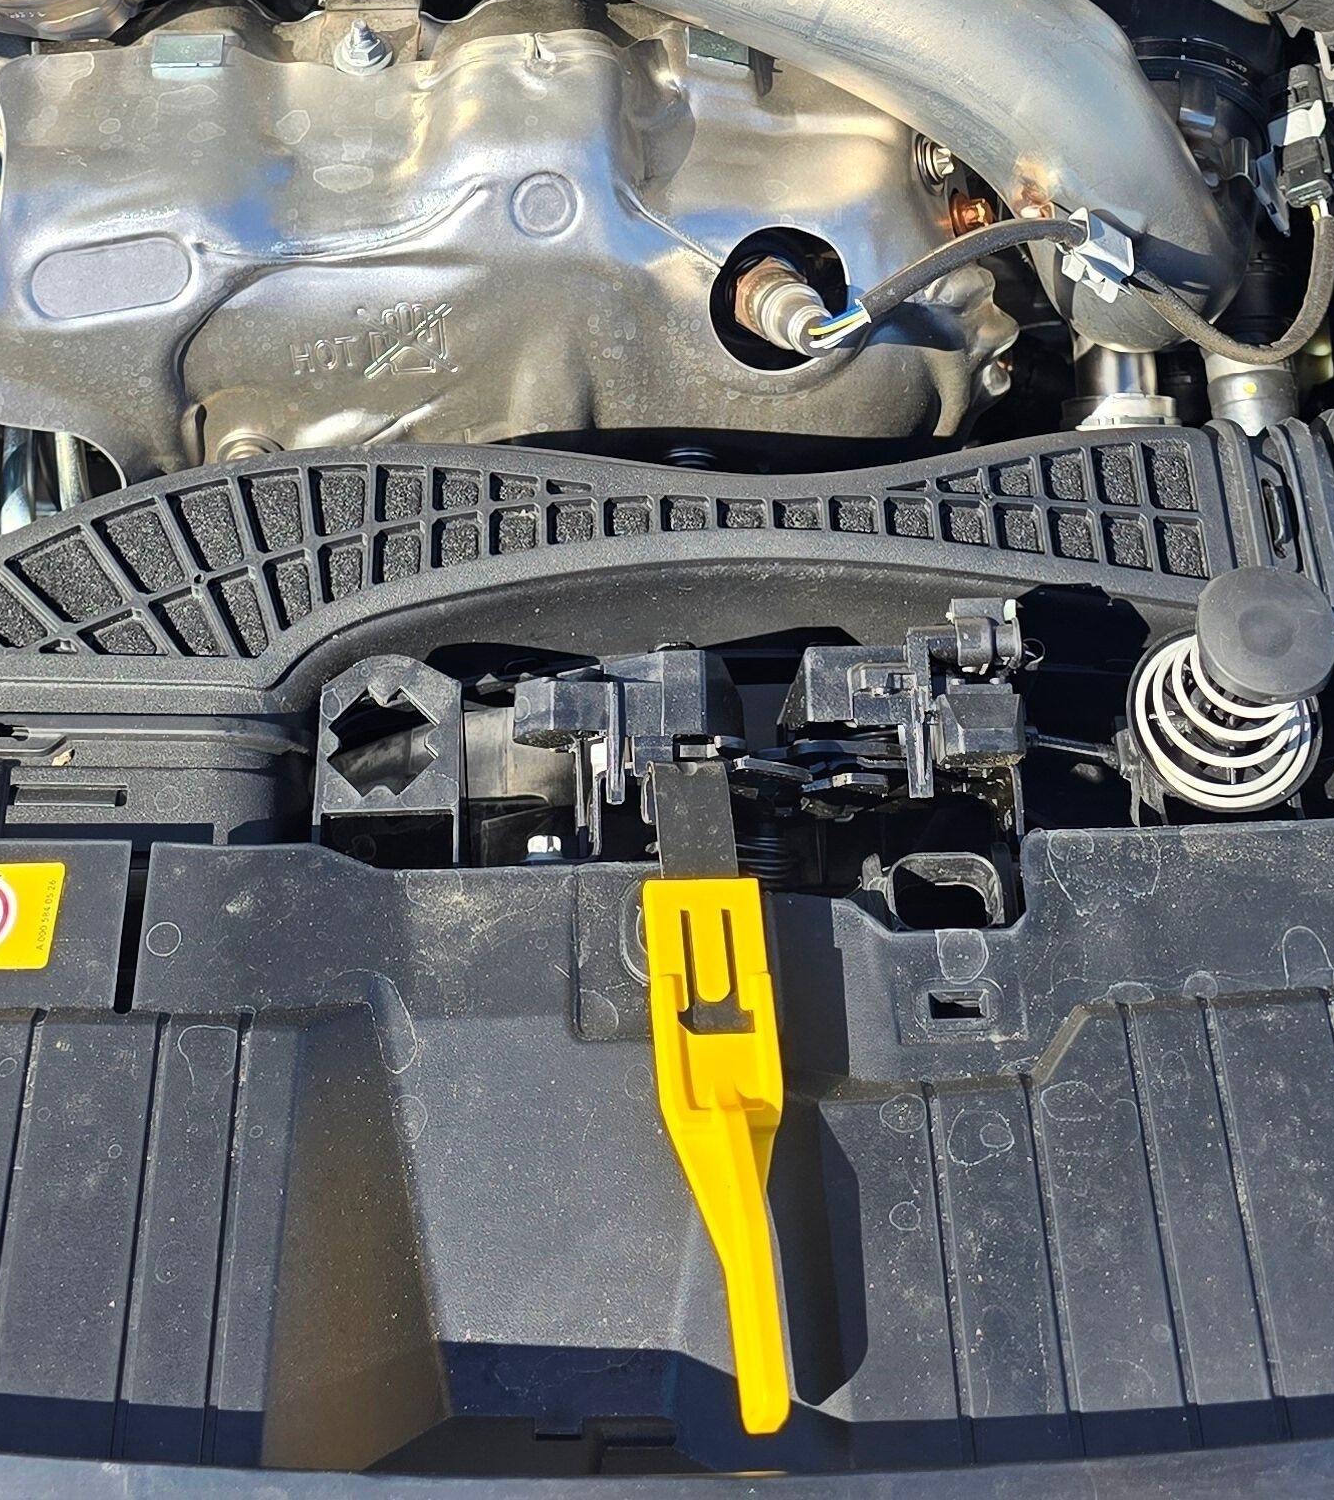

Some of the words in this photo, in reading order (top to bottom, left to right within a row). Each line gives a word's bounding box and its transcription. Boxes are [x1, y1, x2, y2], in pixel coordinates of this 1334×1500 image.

[289, 335, 359, 375] HOT
[45, 893, 54, 904] 05
[41, 907, 51, 923] 584
[37, 925, 48, 942] 000
